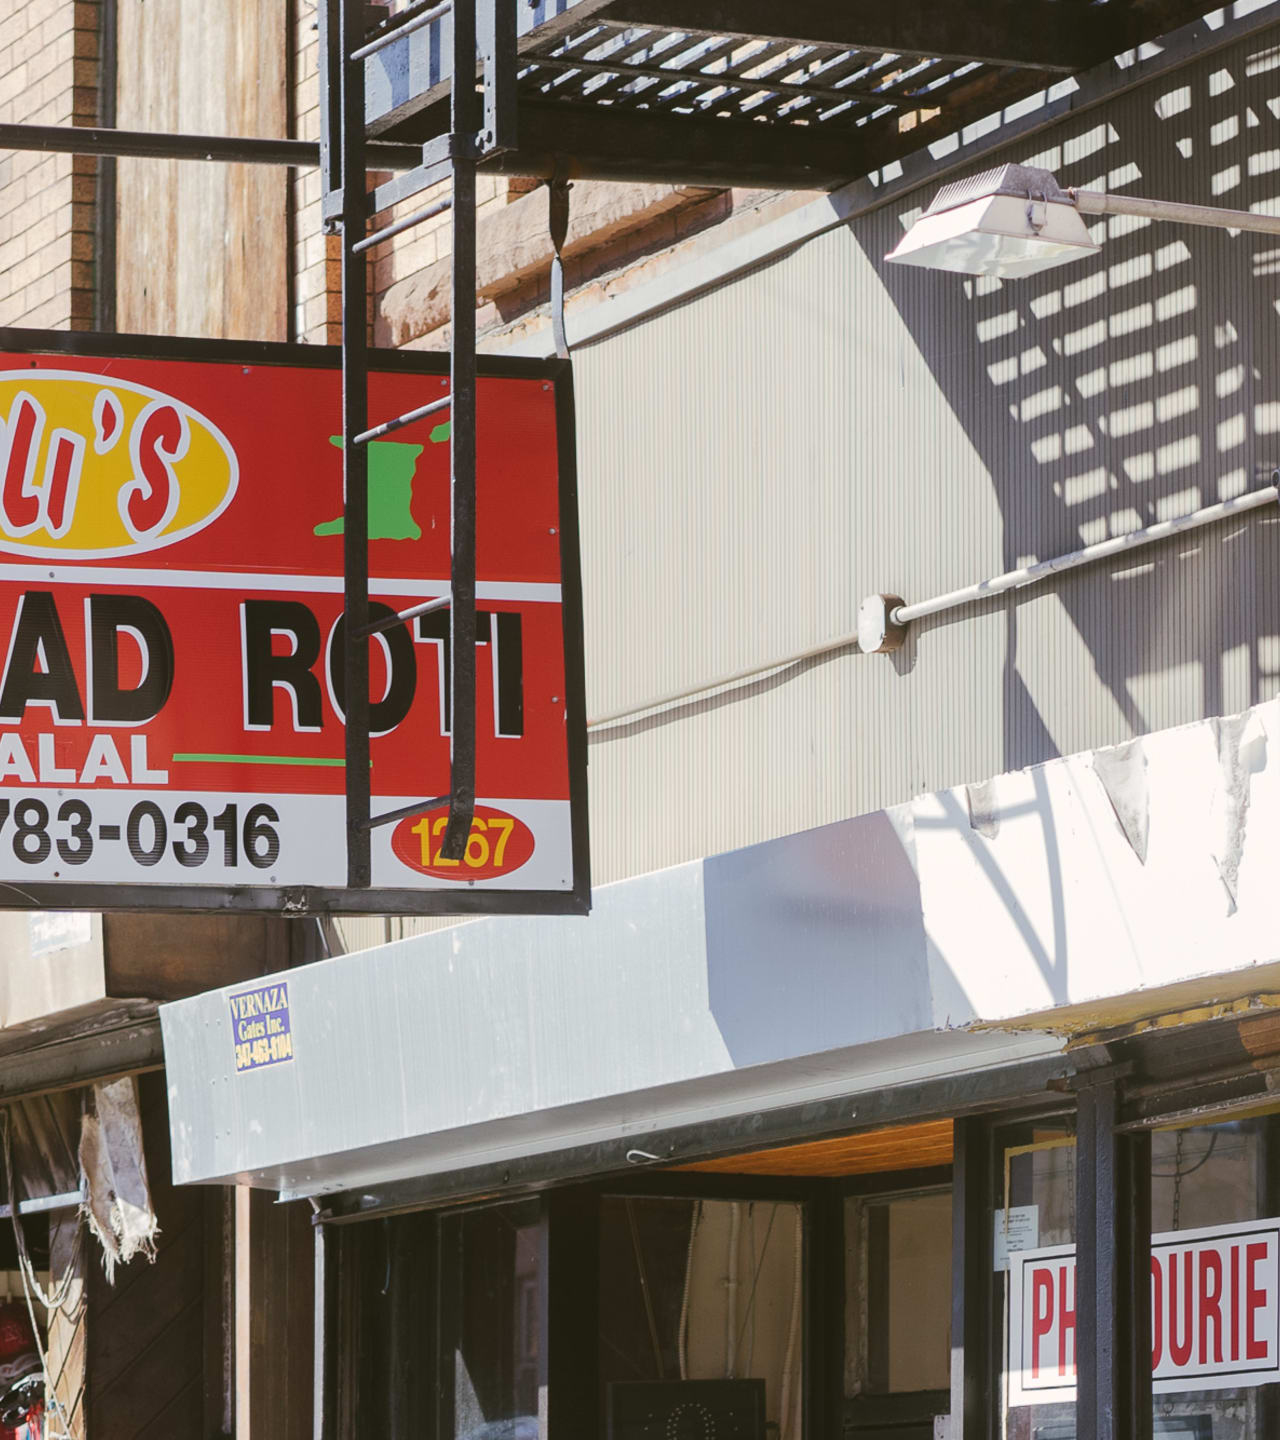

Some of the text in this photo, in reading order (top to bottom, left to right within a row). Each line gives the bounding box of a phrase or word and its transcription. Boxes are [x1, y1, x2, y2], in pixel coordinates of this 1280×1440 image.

[240, 599, 524, 739] ROTI
[411, 817, 514, 868] 1267
[230, 987, 288, 1019] VERNAZA
[238, 1014, 285, 1041] Gates Inc.
